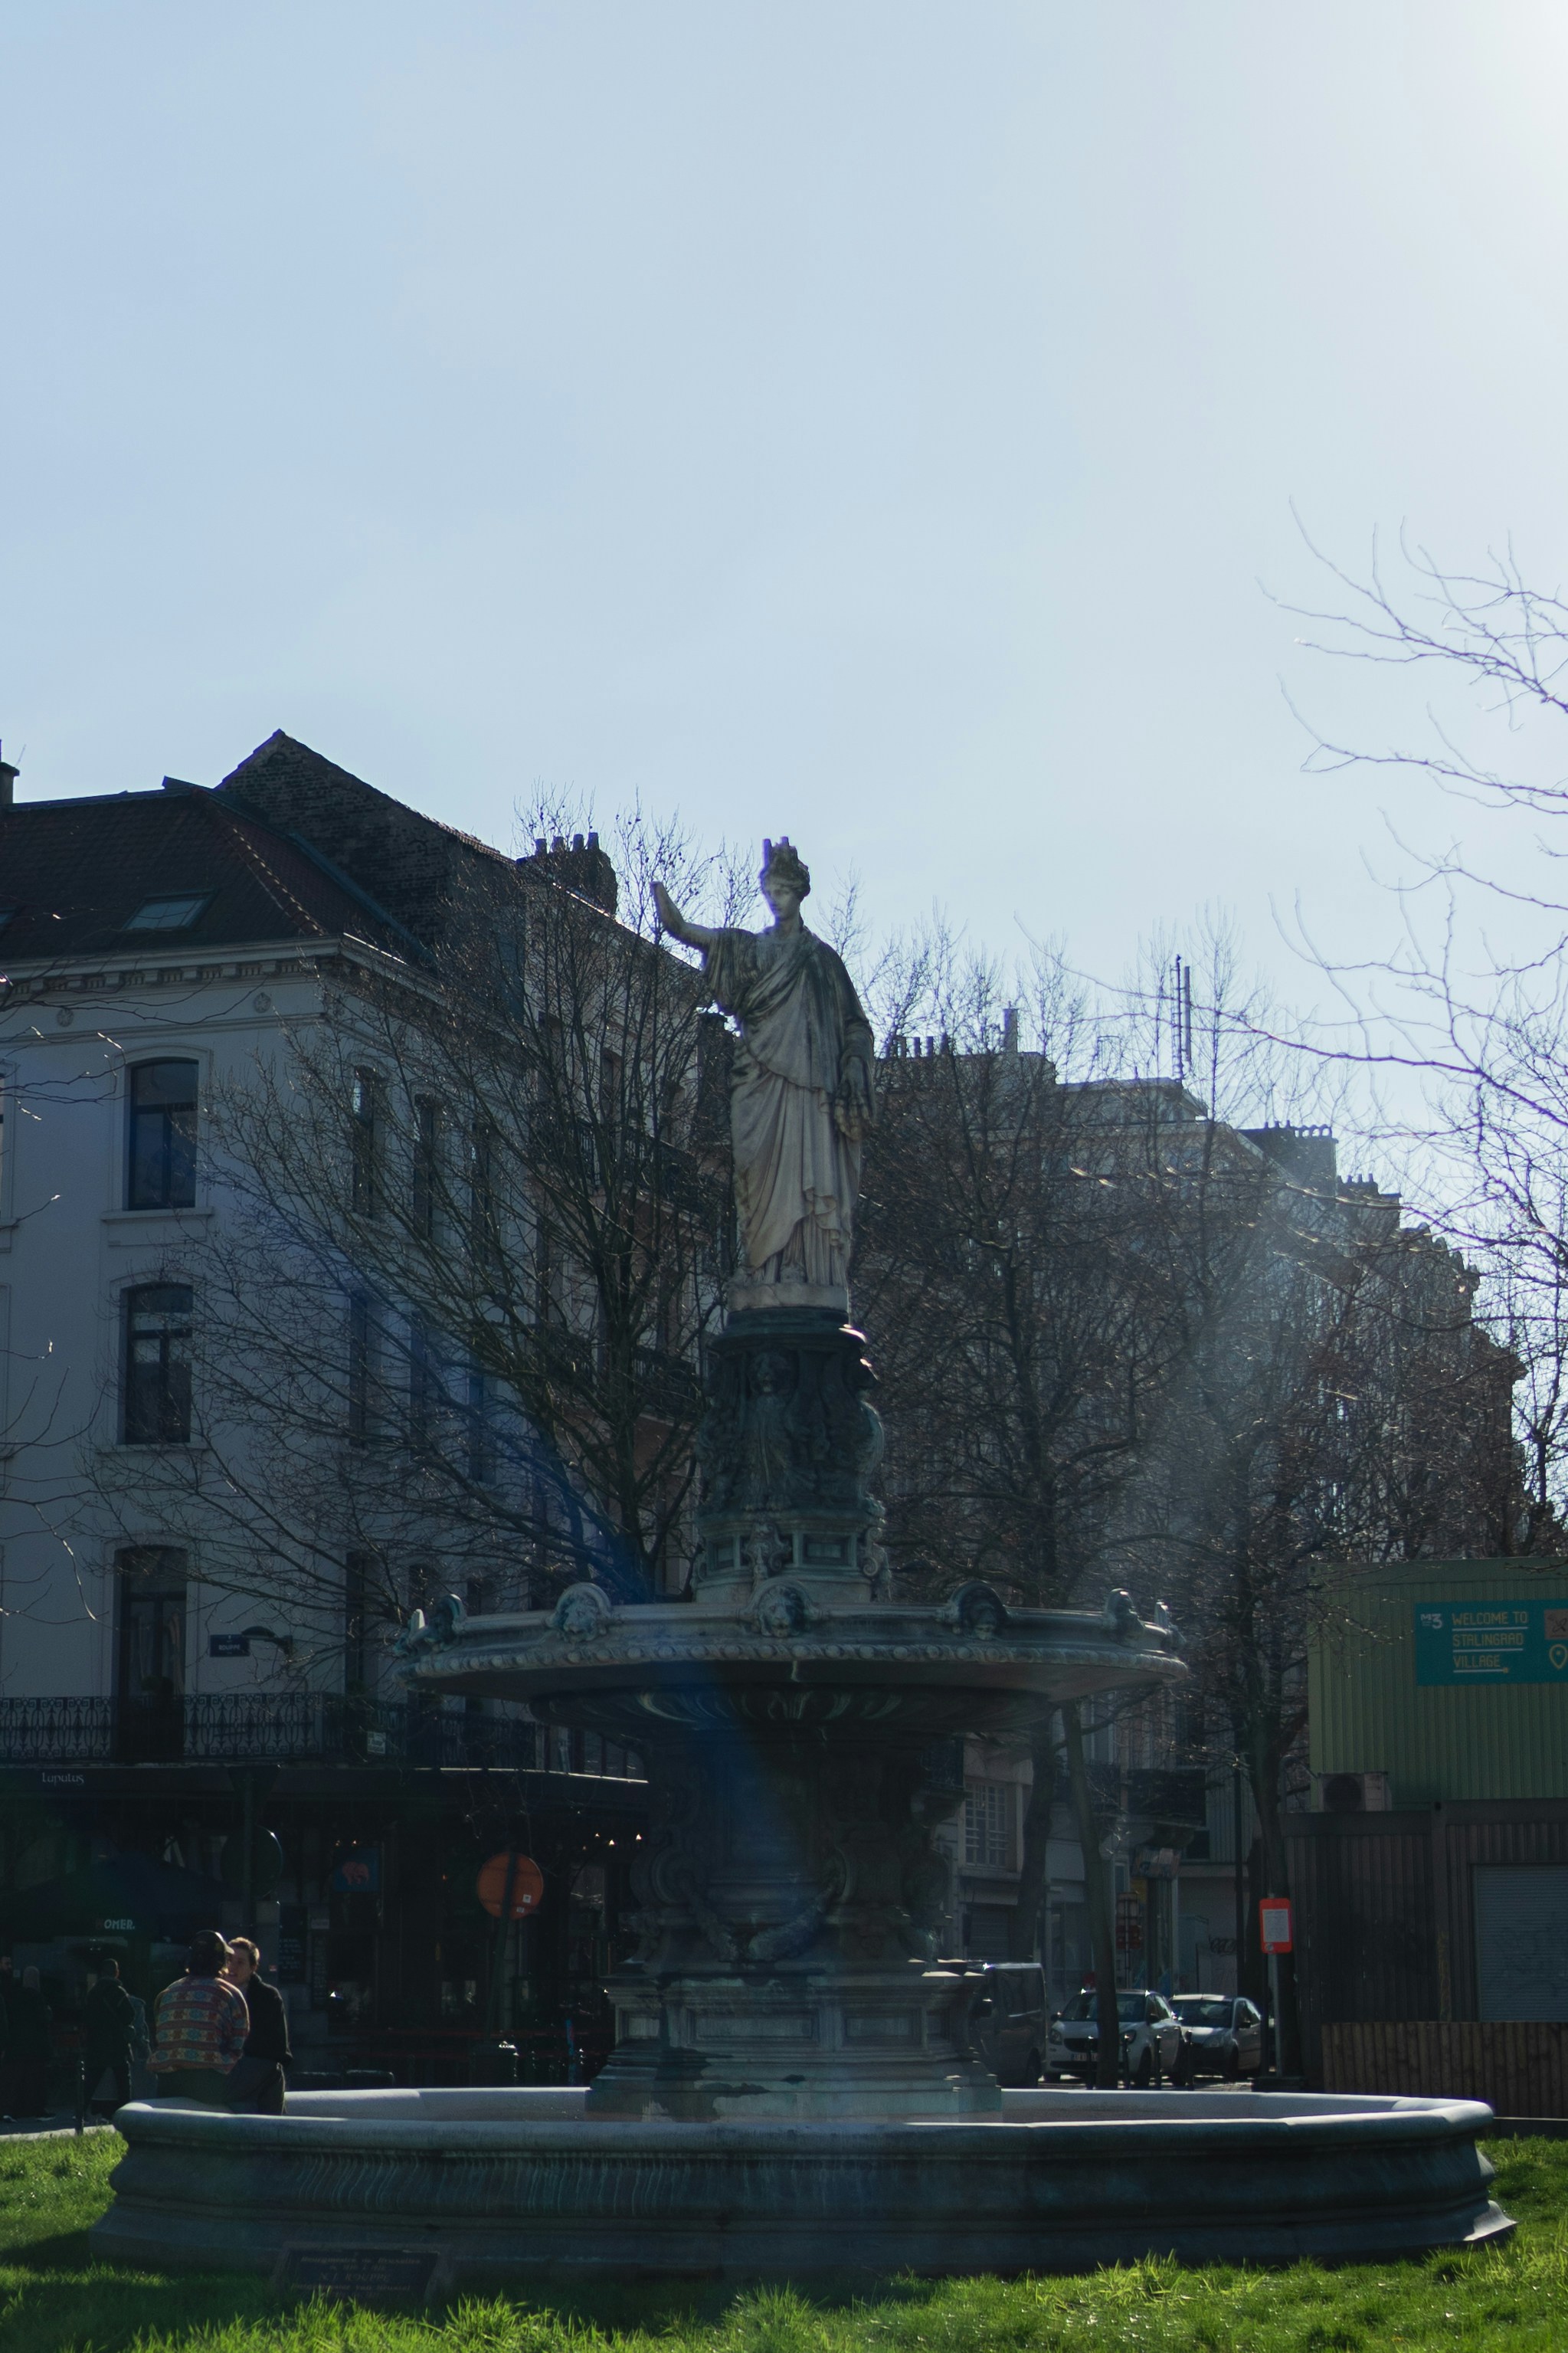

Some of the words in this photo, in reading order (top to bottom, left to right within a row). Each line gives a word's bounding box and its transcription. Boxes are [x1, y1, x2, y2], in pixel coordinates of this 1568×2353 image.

[1420, 1613, 1443, 1630] M3
[1451, 1611, 1508, 1626] WELCOME
[1512, 1611, 1528, 1624] TO
[1452, 1633, 1524, 1647] STALINGRAD
[1453, 1654, 1501, 1668] VILLAGE
